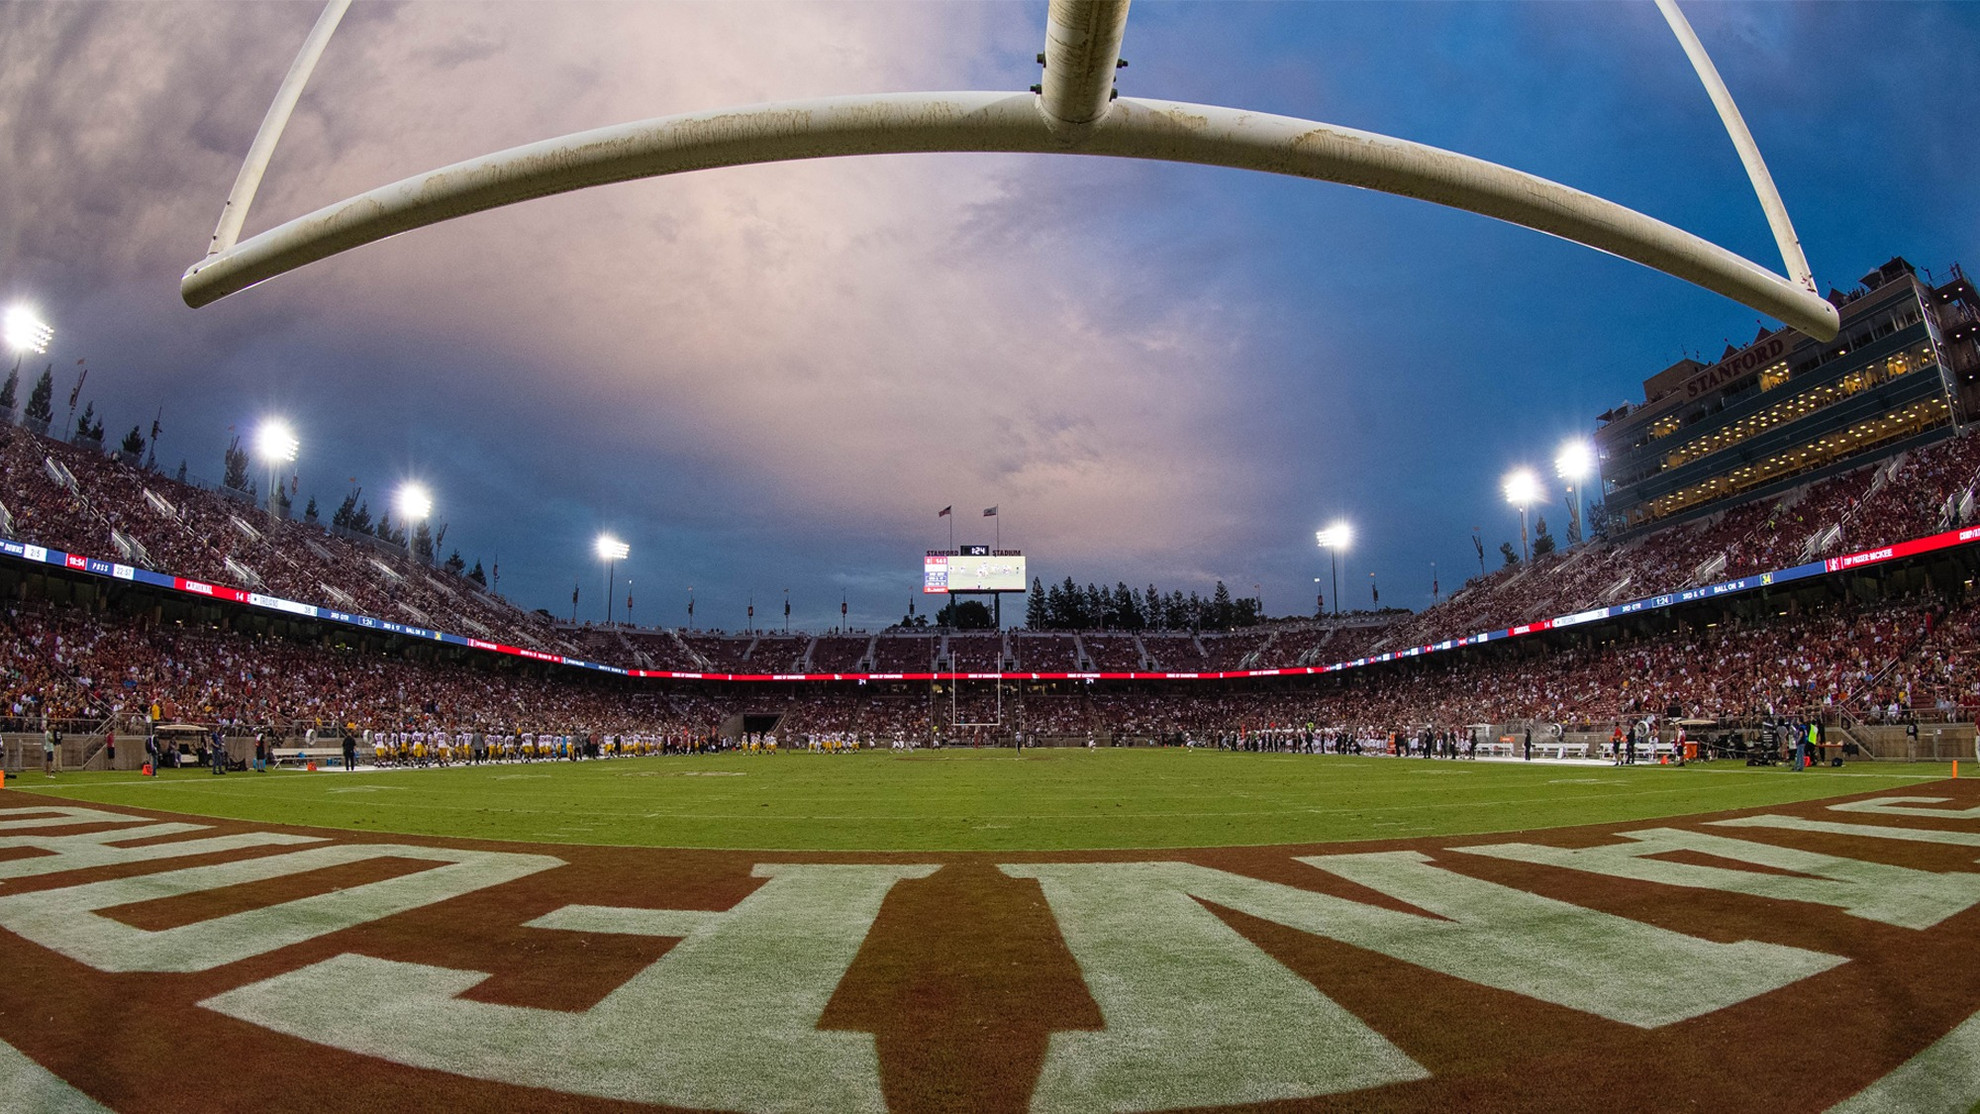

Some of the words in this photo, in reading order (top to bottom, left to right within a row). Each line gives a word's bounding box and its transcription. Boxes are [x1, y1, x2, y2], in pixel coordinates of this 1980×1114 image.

[1686, 338, 1784, 398] STANFORD
[992, 549, 1021, 557] STADIUM
[235, 591, 244, 601] 14
